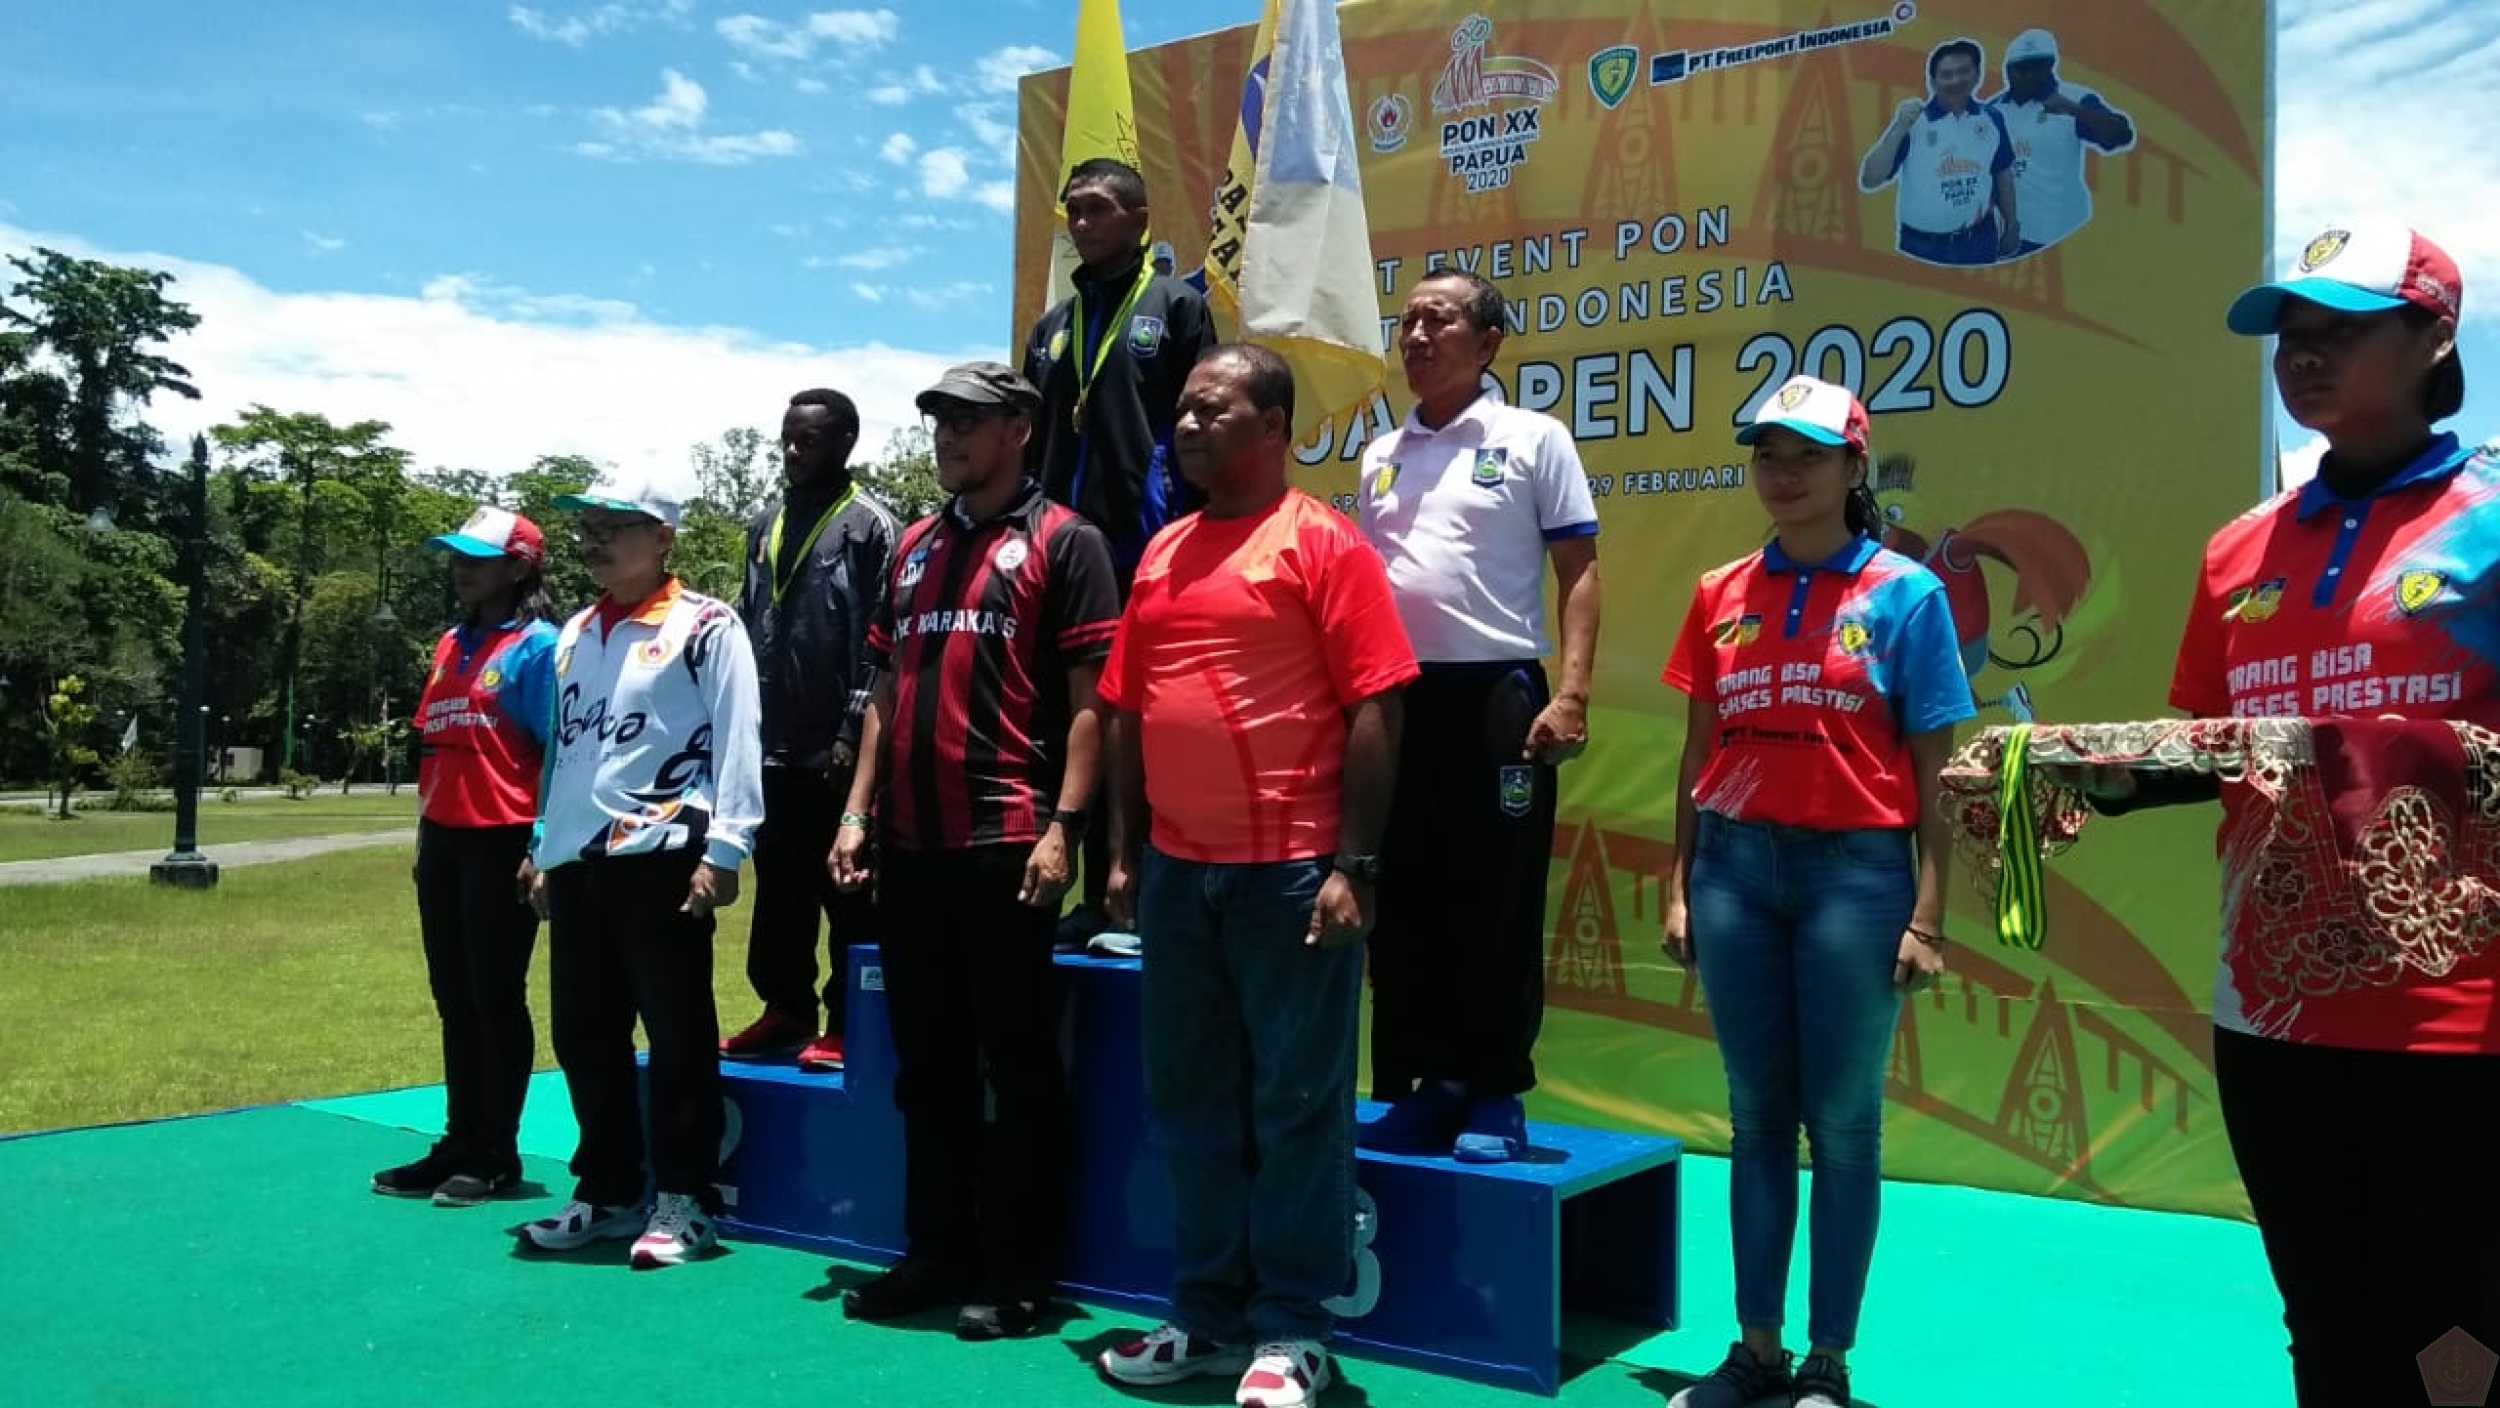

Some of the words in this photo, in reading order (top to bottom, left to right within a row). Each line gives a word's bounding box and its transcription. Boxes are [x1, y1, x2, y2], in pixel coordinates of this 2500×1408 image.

[1689, 54, 1713, 72] PT
[1800, 18, 1891, 49] INDONESIA
[1443, 115, 1496, 147] PON
[1505, 108, 1539, 135] XX
[1452, 144, 1526, 173] PAPUA
[1468, 169, 1509, 190] 2020
[1426, 228, 1588, 279] EVENT
[1615, 204, 1730, 260] PON
[1503, 260, 1794, 335] NDONESIA
[1733, 308, 2011, 427] 2020
[1623, 464, 1748, 496] FEBRUARI
[2311, 642, 2373, 679] BISA
[2312, 671, 2461, 714] PRESTASI
